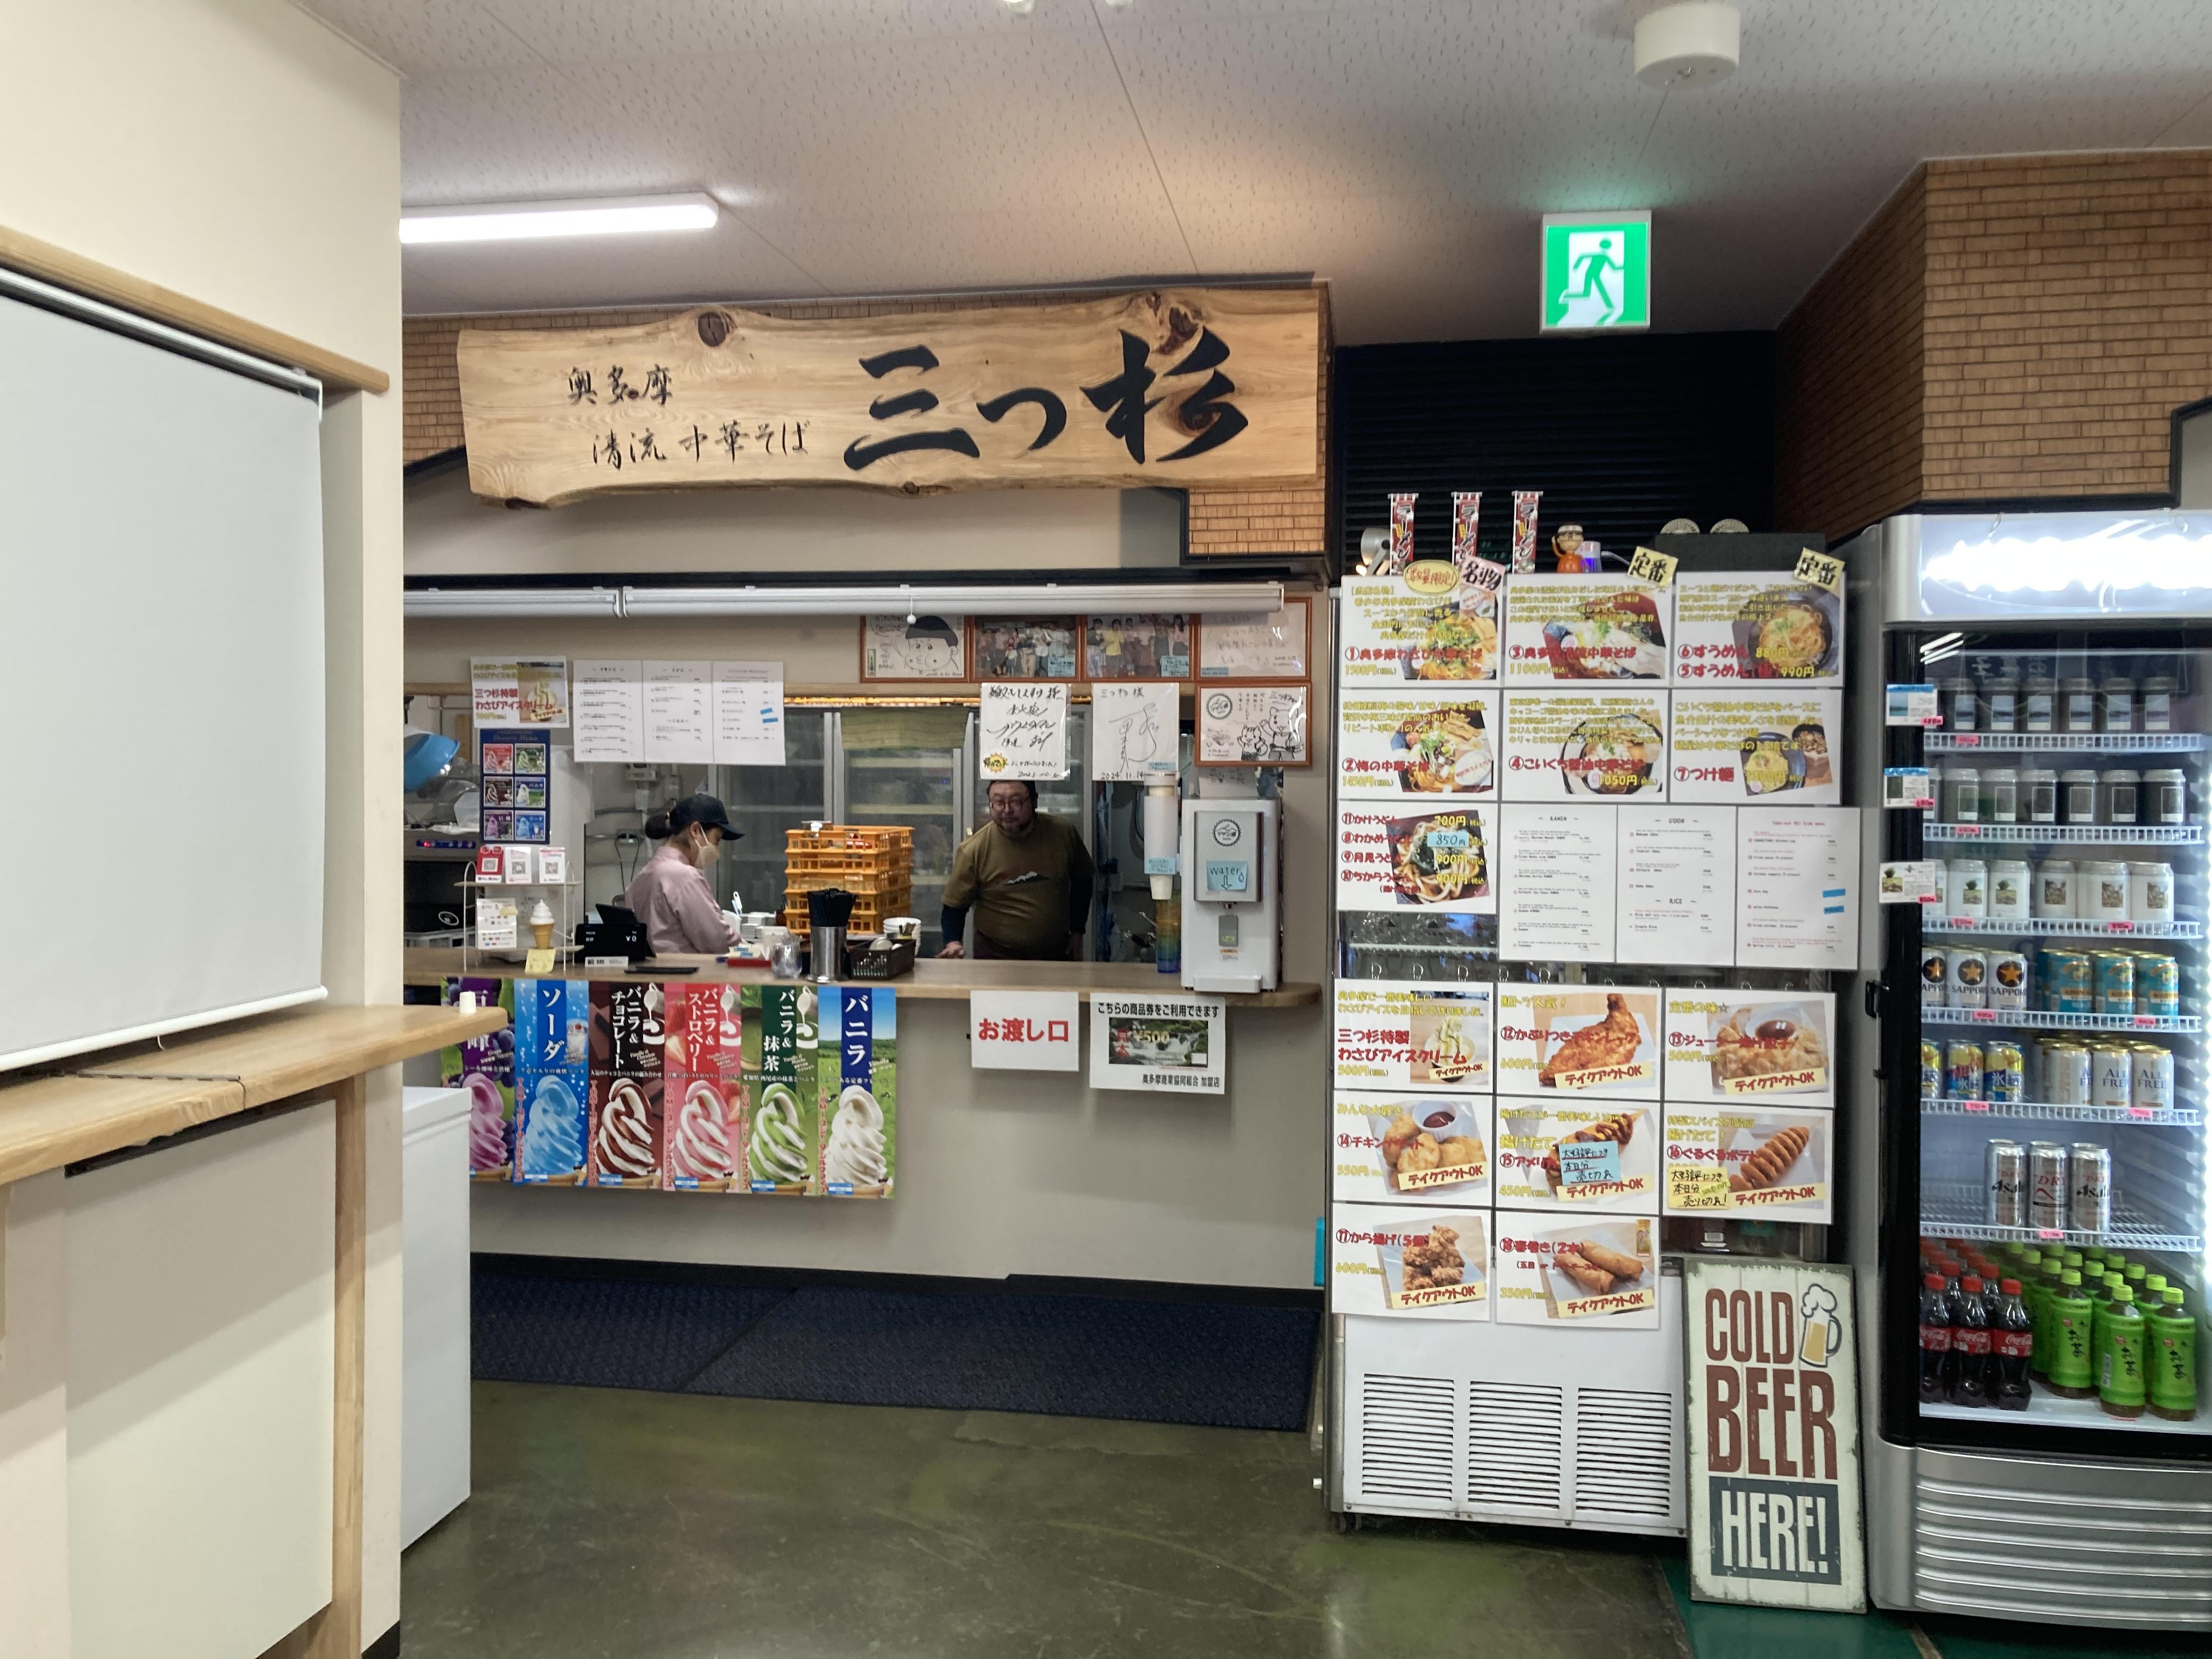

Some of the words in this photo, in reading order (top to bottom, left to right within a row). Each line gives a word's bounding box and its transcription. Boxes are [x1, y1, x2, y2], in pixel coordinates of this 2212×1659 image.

[568, 364, 673, 406] 奥多摩
[844, 326, 1249, 471] 三つ杉
[1464, 561, 1502, 591] 名物
[1630, 553, 1668, 583] 定番
[1799, 556, 1838, 585] 定番
[475, 688, 518, 698] 三つ杉特製
[476, 701, 553, 710] わさびアイスクリーム
[1342, 757, 1430, 772] ②梅の中華そば
[1674, 766, 1735, 782] ⑦つけ麺
[1436, 834, 1465, 846] 850円
[1210, 866, 1241, 876] water
[1338, 990, 1433, 1002] 奥多摩で一番美味しい
[1952, 985, 1987, 994] SAPPOR
[627, 986, 641, 1045] バニラ&
[703, 988, 718, 1046] バニラ&
[779, 988, 795, 1048] バニラ&
[1098, 1002, 1219, 1018] こちらの商品券をご利用できます
[1338, 1004, 1484, 1017] わさびアイスを目指して作りました。
[543, 988, 565, 1062] ソーダ
[612, 991, 625, 1069] チョコレート
[687, 992, 703, 1072] ストロベリー
[845, 995, 868, 1066] バニラ
[978, 1017, 1069, 1042] お渡し口
[1115, 1029, 1130, 1058] 見本
[1338, 1028, 1410, 1044] 三つ杉特製
[764, 1035, 780, 1073] 抹茶
[1338, 1047, 1467, 1064] わさびアイスクリーム
[1435, 1063, 1483, 1077] テイクアウトOK
[1565, 1065, 1643, 1086] テイクアウトOK
[2141, 1069, 2162, 1079] ALL
[1142, 1074, 1199, 1087] 奥多摩商業協同組合
[1201, 1075, 1220, 1087] 加盟店
[1735, 1071, 1815, 1092] テイクアウトOK
[2102, 1078, 2129, 1088] FRE
[2138, 1079, 2166, 1089] FREE
[1337, 1103, 1403, 1116] みんな大好き
[1563, 1148, 1609, 1158] 大好評につき
[1408, 1165, 1483, 1186] テイクアウトOK
[1565, 1161, 1589, 1171] 本日分
[1672, 1170, 1724, 1182] 大好評につき
[1567, 1178, 1644, 1198] テイクアウトOK
[1674, 1183, 1699, 1194] 本日分
[1992, 1180, 2026, 1194] Asah
[2038, 1175, 2067, 1186] DRY
[1735, 1186, 1815, 1206] テイクアウトOK
[1401, 1285, 1476, 1305] テイクアウトOK
[1567, 1293, 1644, 1313] テイクアウトOK
[1705, 1288, 1795, 1365] COLD
[1706, 1364, 1838, 1480] BEER
[1721, 1490, 1829, 1574] HERE!
